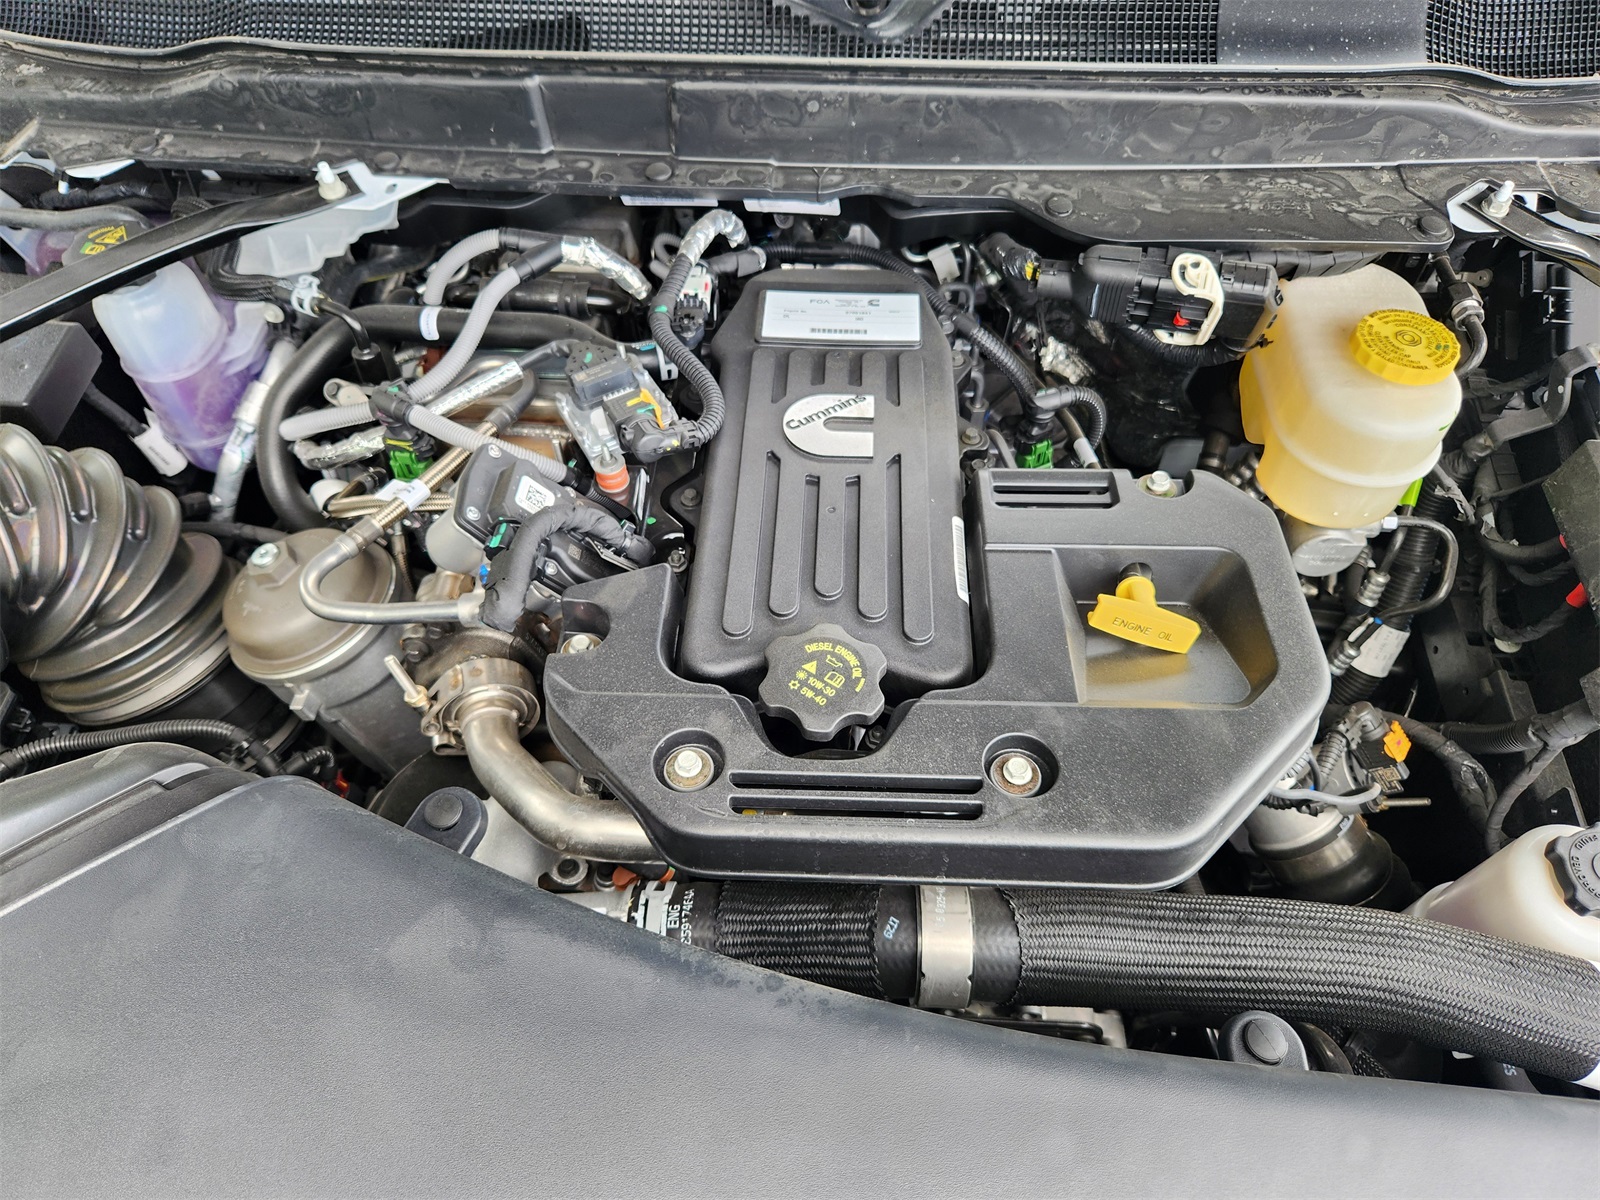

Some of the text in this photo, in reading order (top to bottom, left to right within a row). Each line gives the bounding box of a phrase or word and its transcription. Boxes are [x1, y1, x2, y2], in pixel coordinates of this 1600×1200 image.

[785, 395, 867, 430] Cummins
[1112, 617, 1173, 641] ENGINE OIL
[804, 642, 863, 679] DIESEL ENGINE OIL
[800, 686, 827, 706] 5W-40
[807, 676, 836, 697] 10W-30
[666, 904, 681, 930] ENG
